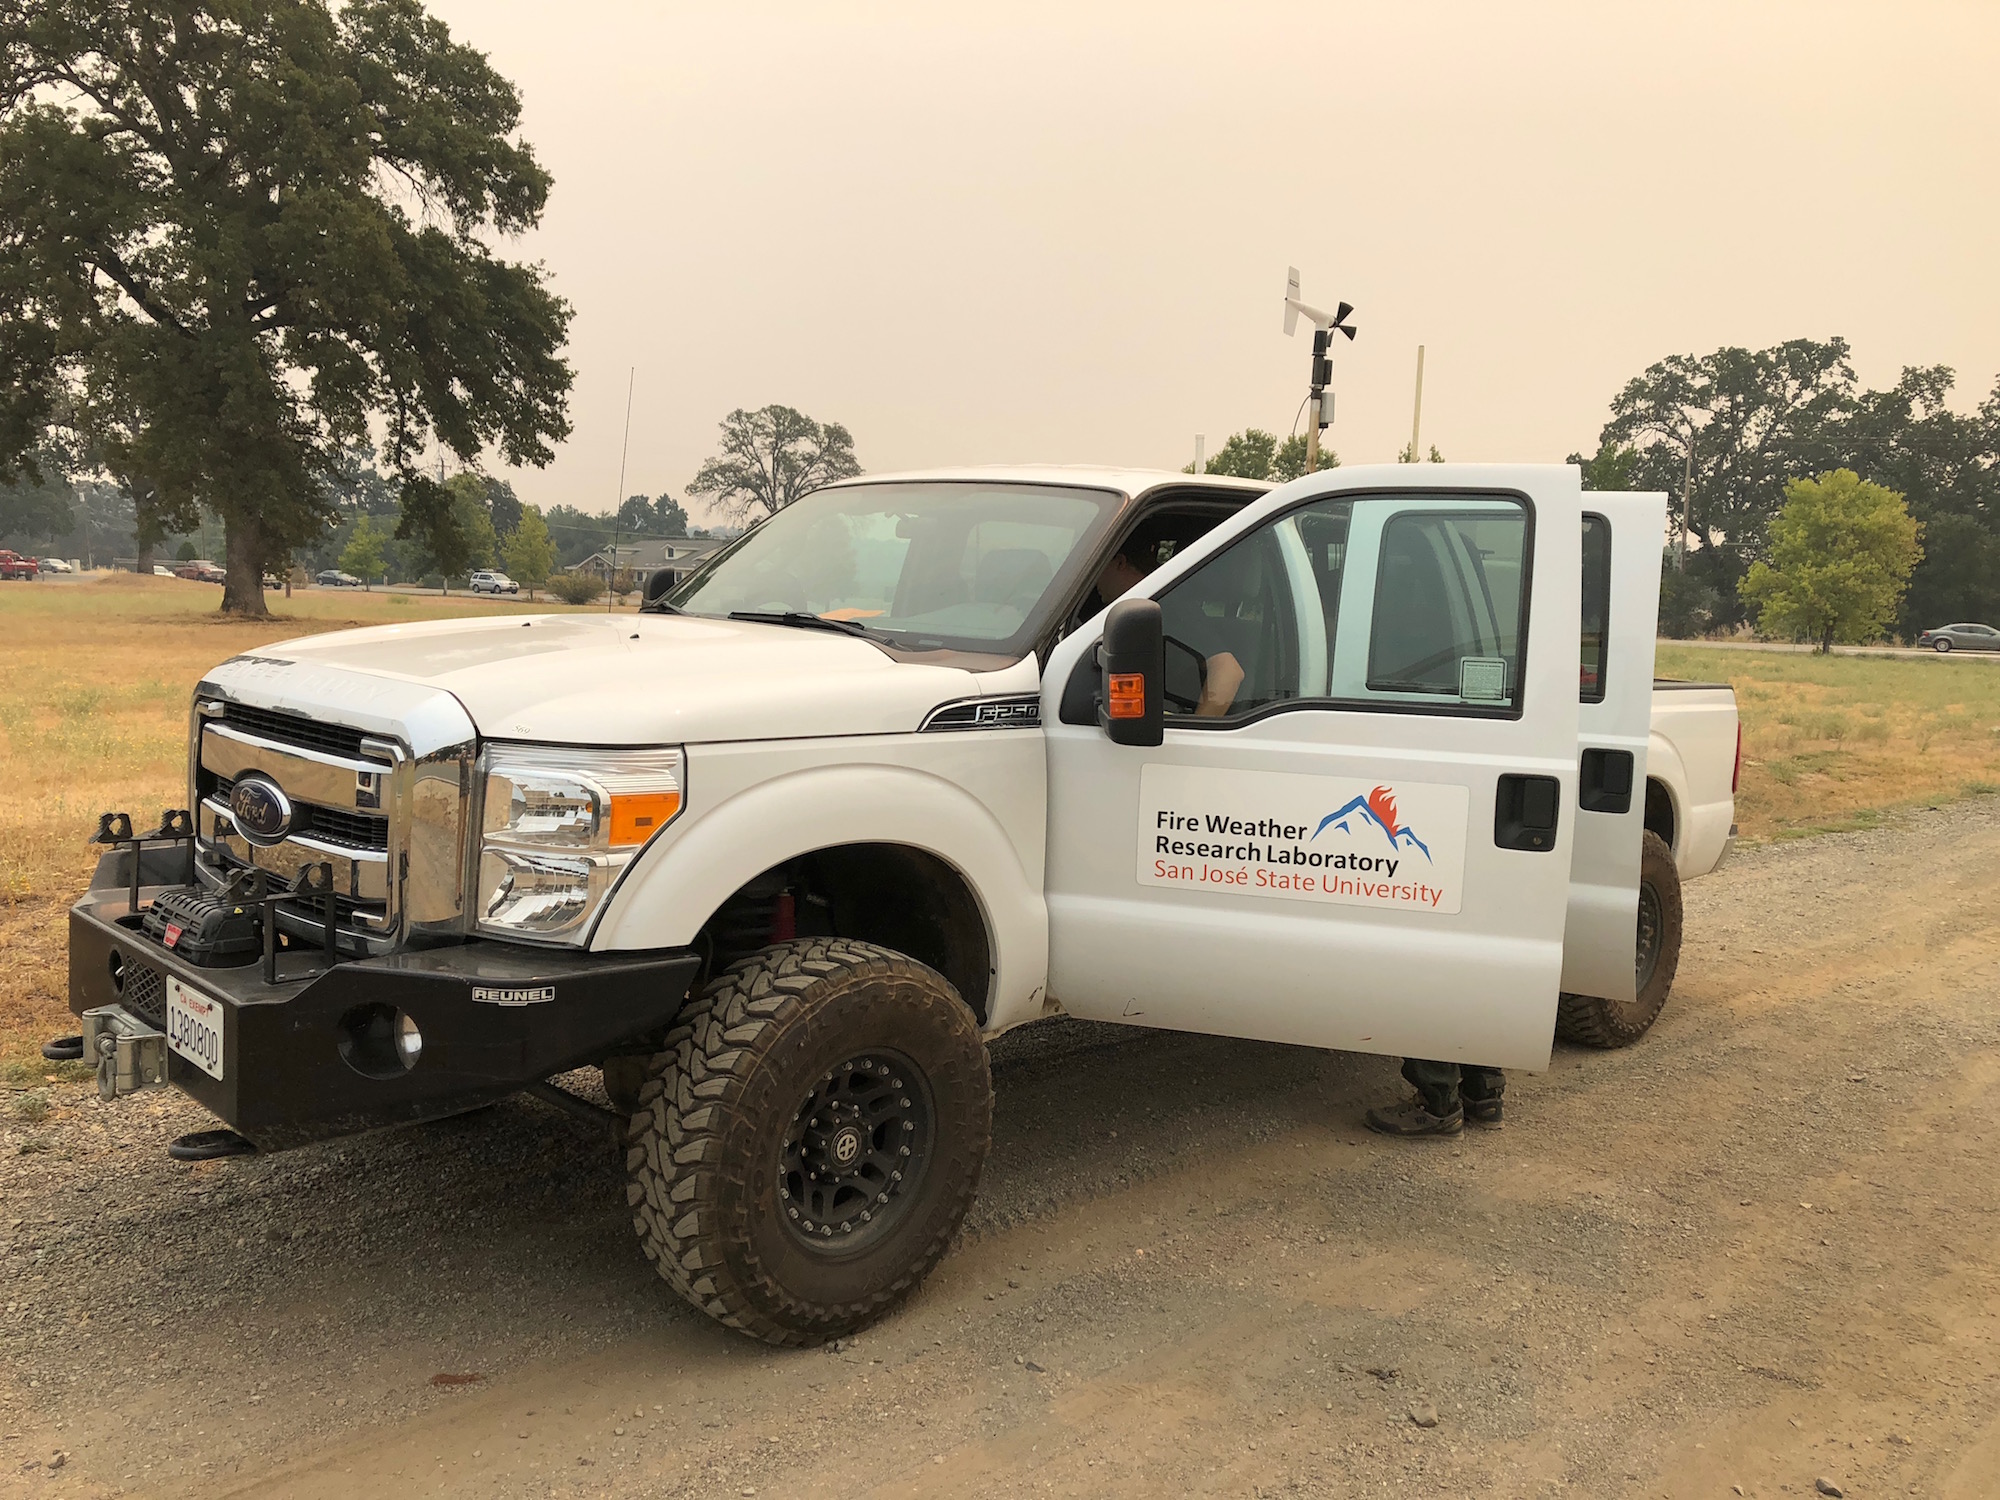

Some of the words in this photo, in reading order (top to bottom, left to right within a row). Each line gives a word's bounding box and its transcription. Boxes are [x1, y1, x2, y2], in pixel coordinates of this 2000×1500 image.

[977, 704, 1040, 722] F-250
[236, 786, 269, 825] Ford
[1156, 810, 1200, 832] Fire
[1204, 814, 1308, 841] Weather
[1155, 834, 1262, 862] Research
[1266, 844, 1400, 878] Laboratory
[1153, 859, 1195, 881] San
[1199, 864, 1249, 886] José
[1254, 868, 1316, 892] State
[1322, 874, 1444, 907] University
[474, 988, 553, 1002] REUNEL
[170, 1006, 218, 1065] 1380800
